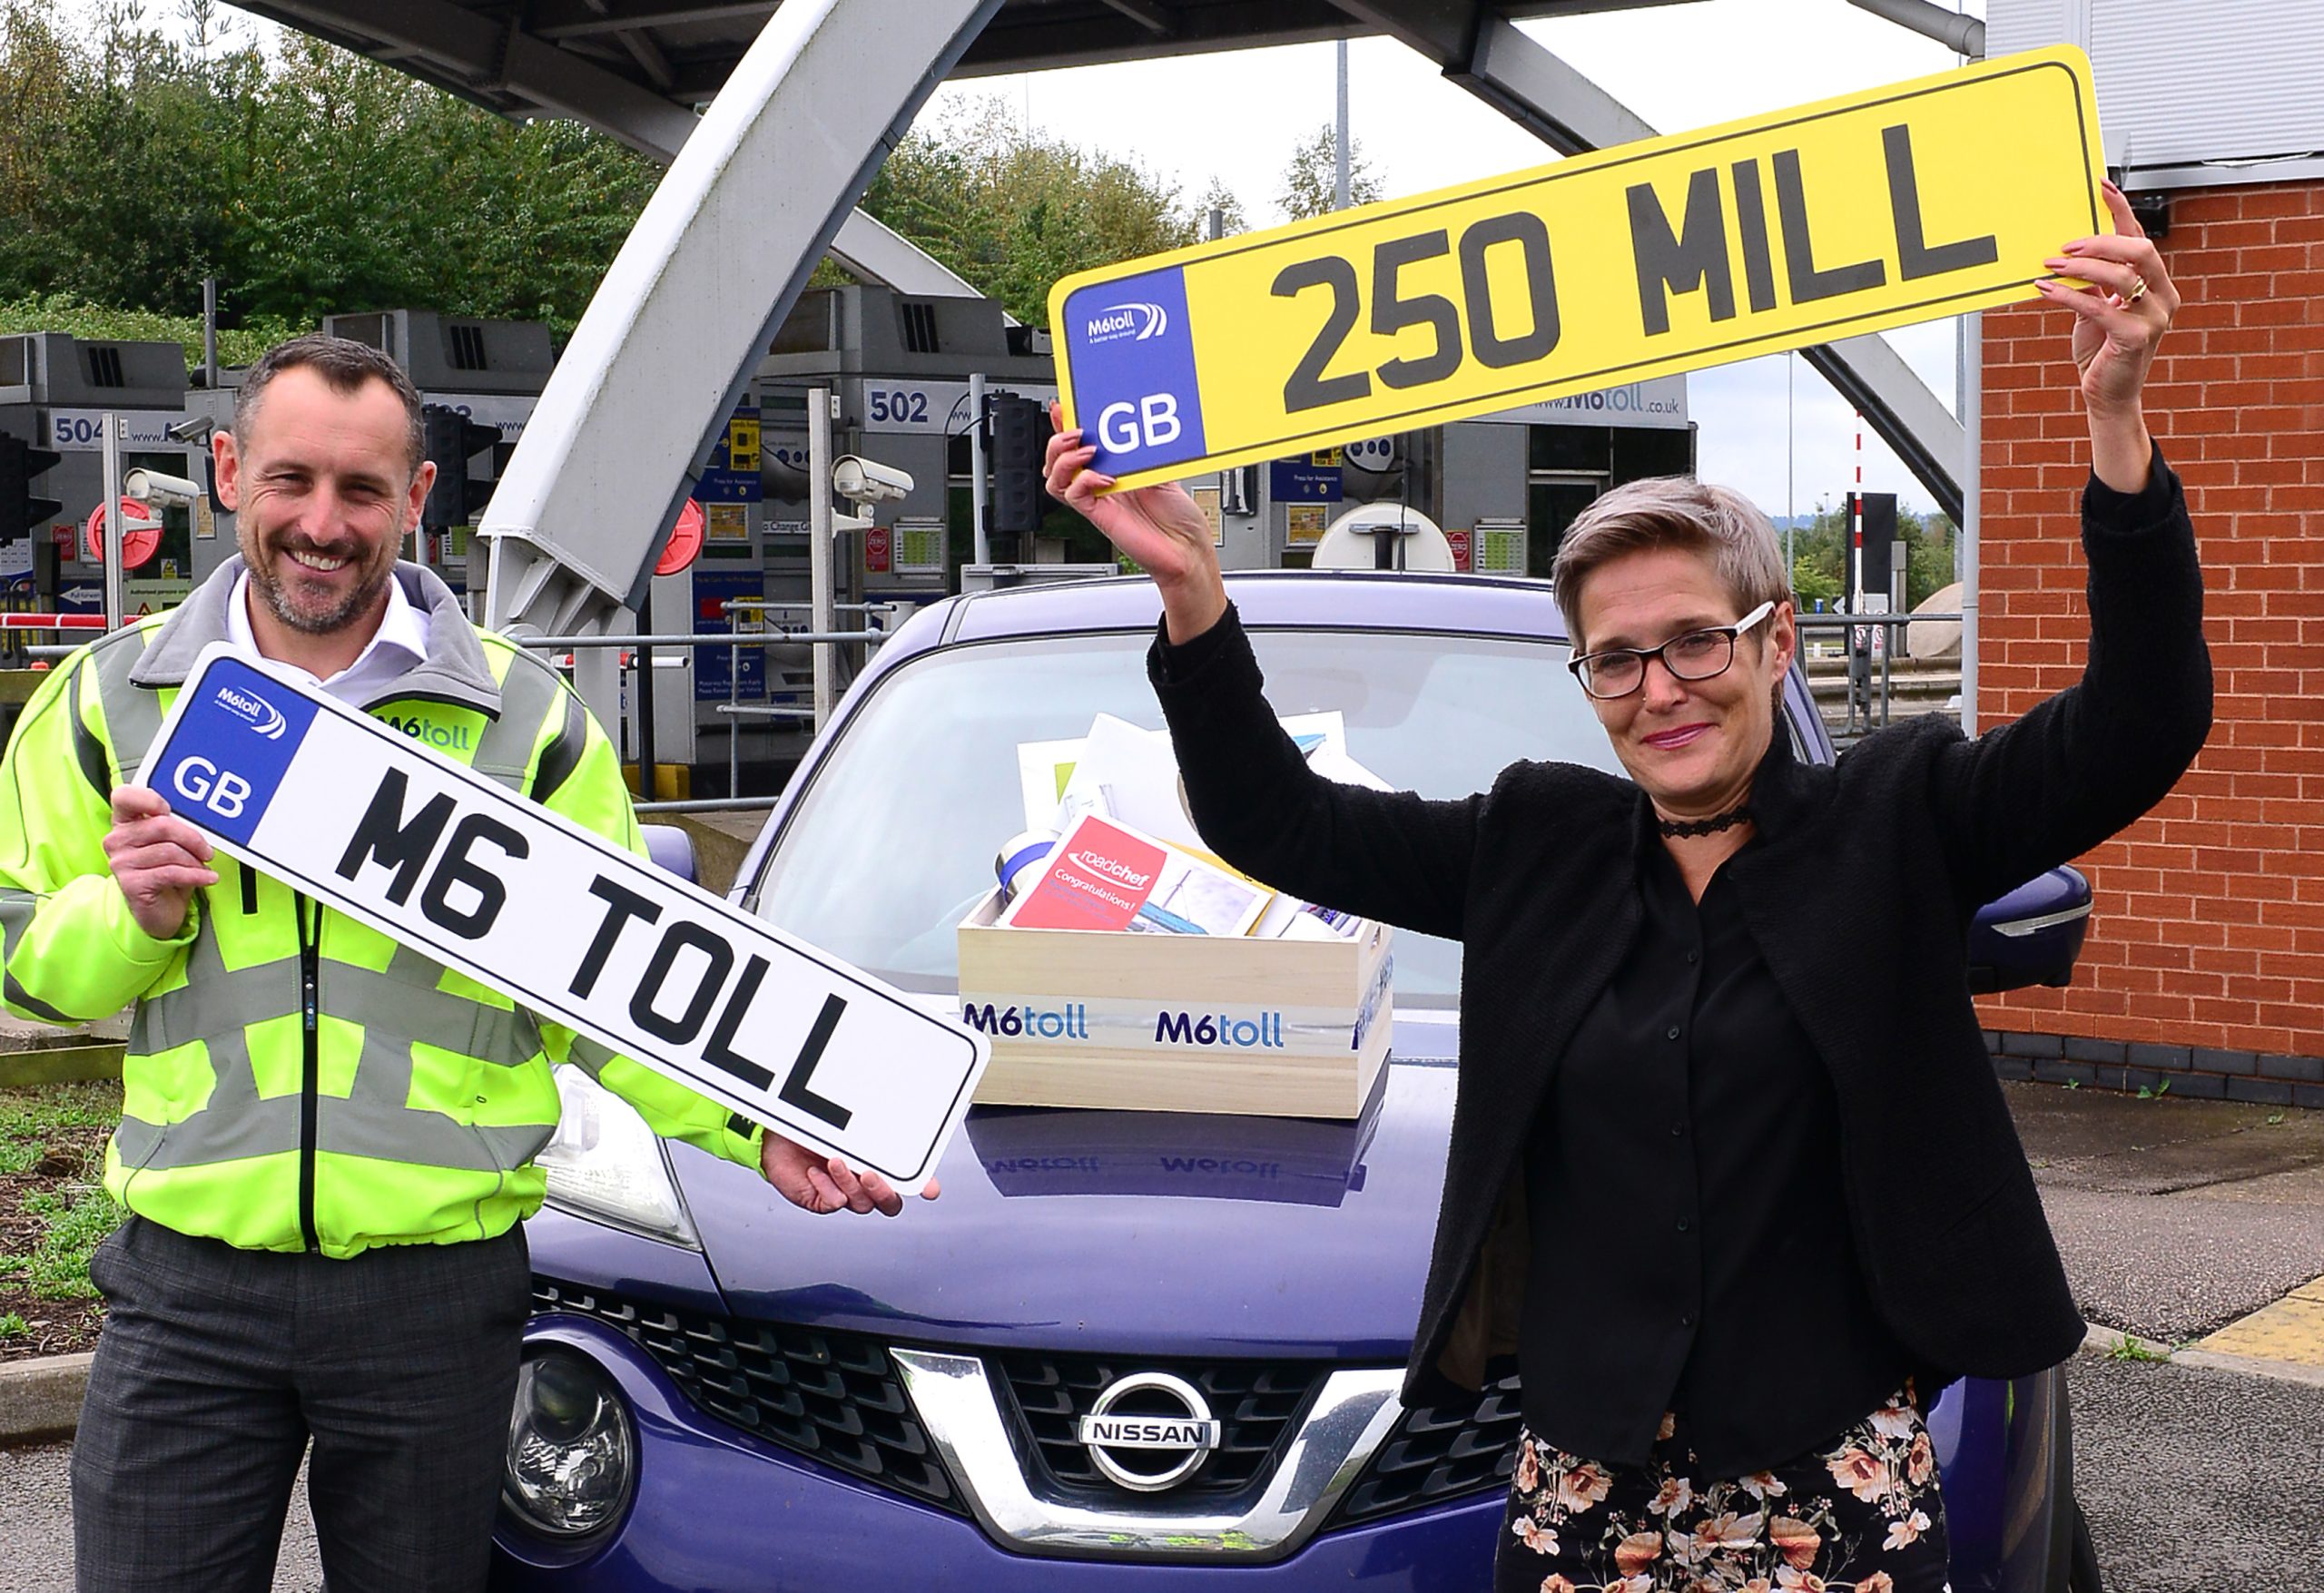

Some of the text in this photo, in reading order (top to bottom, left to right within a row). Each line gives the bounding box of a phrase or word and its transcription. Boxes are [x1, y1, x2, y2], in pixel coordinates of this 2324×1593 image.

[1271, 123, 1998, 414] 250 MILL
[1088, 310, 1135, 337] M6toll
[871, 391, 928, 423] 502
[1098, 393, 1181, 454] GB
[218, 687, 261, 717] M6toll
[172, 755, 251, 819] GB
[1080, 851, 1149, 887] roadchef
[1055, 869, 1136, 912] Congratulations!
[335, 766, 852, 1131] M6 TOLL
[963, 1002, 1088, 1039] M6toll
[1155, 1010, 1284, 1047] M6toll
[1093, 1422, 1204, 1443] NISSAN
